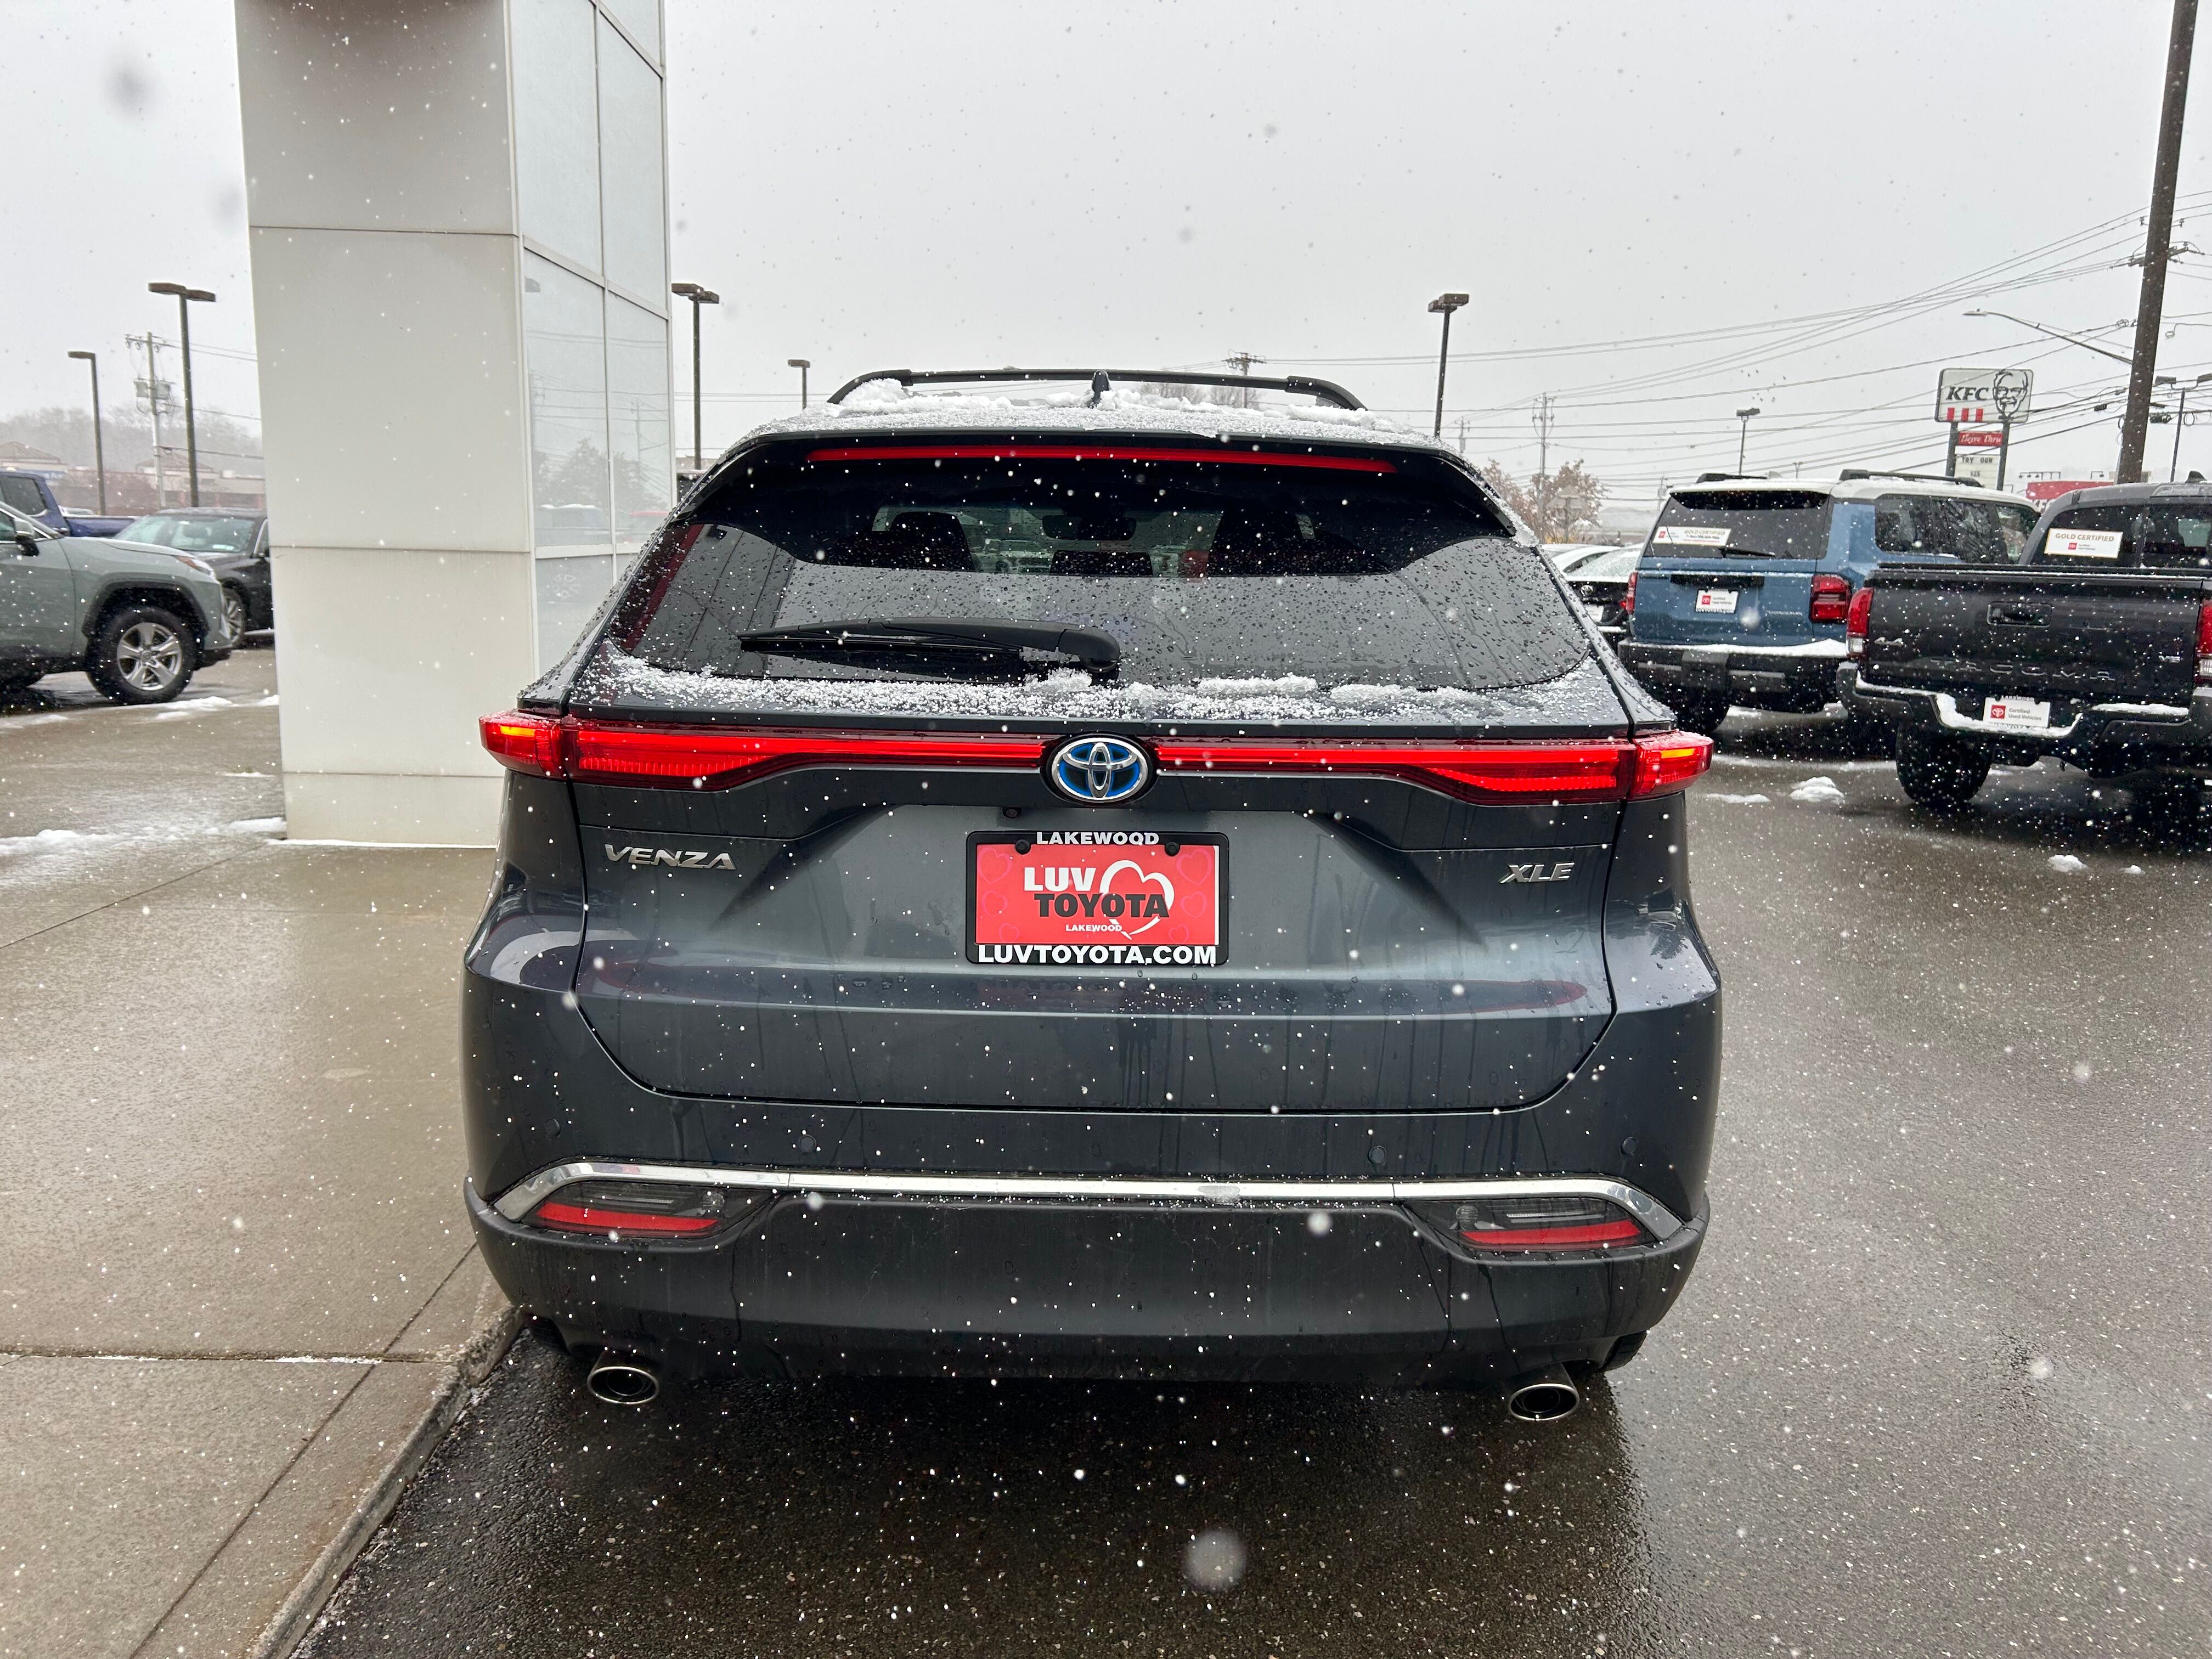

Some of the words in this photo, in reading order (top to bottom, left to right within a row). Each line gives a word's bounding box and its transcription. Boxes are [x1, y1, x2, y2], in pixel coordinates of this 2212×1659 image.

[1946, 386, 1989, 401] KFC
[1961, 433, 1982, 443] Drive
[1983, 433, 2001, 443] Thru
[1036, 832, 1159, 845] LAKEWOOD
[605, 844, 736, 870] VENZA
[1024, 867, 1097, 892] LUV
[1498, 862, 1575, 884] XLE
[1034, 893, 1170, 918] TOYOTA
[1065, 924, 1122, 932] LAKEWOOD
[978, 945, 1216, 964] LUVTOYOTA.COM
